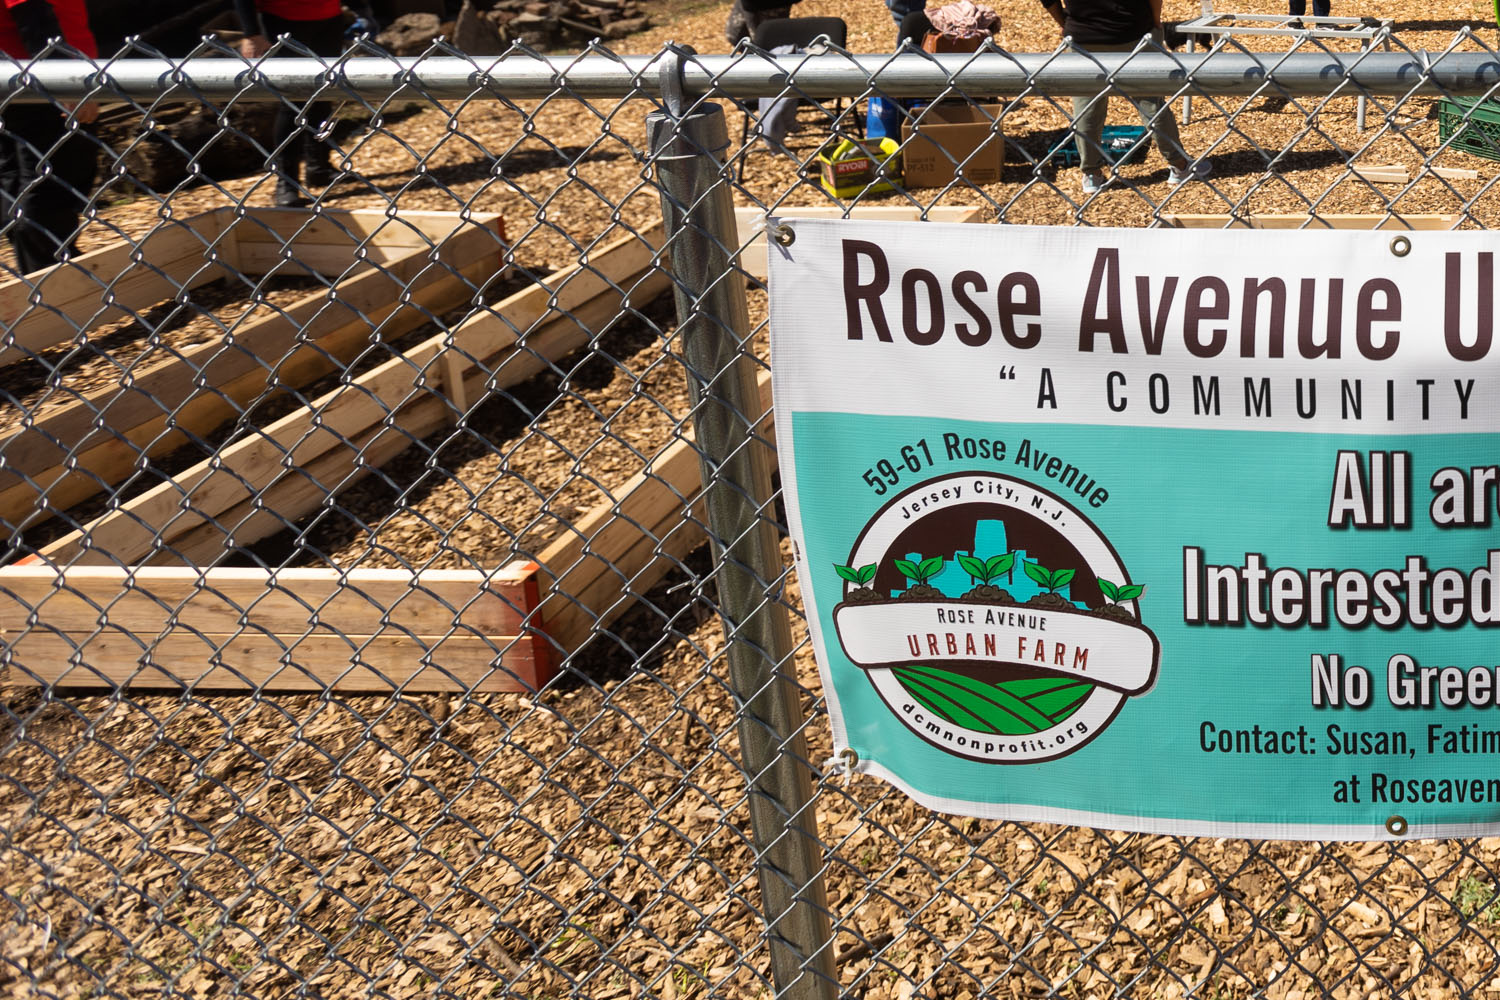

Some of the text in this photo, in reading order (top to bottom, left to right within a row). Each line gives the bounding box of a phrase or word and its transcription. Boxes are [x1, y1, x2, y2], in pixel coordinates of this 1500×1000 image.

[838, 160, 868, 172] RYOBI
[841, 238, 1042, 350] Rose
[1078, 247, 1402, 362] Avenue
[1106, 370, 1476, 422] COMMUNITY
[862, 432, 1110, 509] 59-61 Rose Avenue
[1328, 449, 1409, 528] All
[900, 480, 1067, 527] Jersey City, N.J.
[907, 633, 1090, 671] URBAN FARM
[1310, 653, 1371, 708] No
[902, 702, 1089, 753] dcmnonprofit.org
[1199, 720, 1316, 755] Contact:
[1326, 723, 1416, 760] Susan,
[1333, 774, 1361, 804] at
